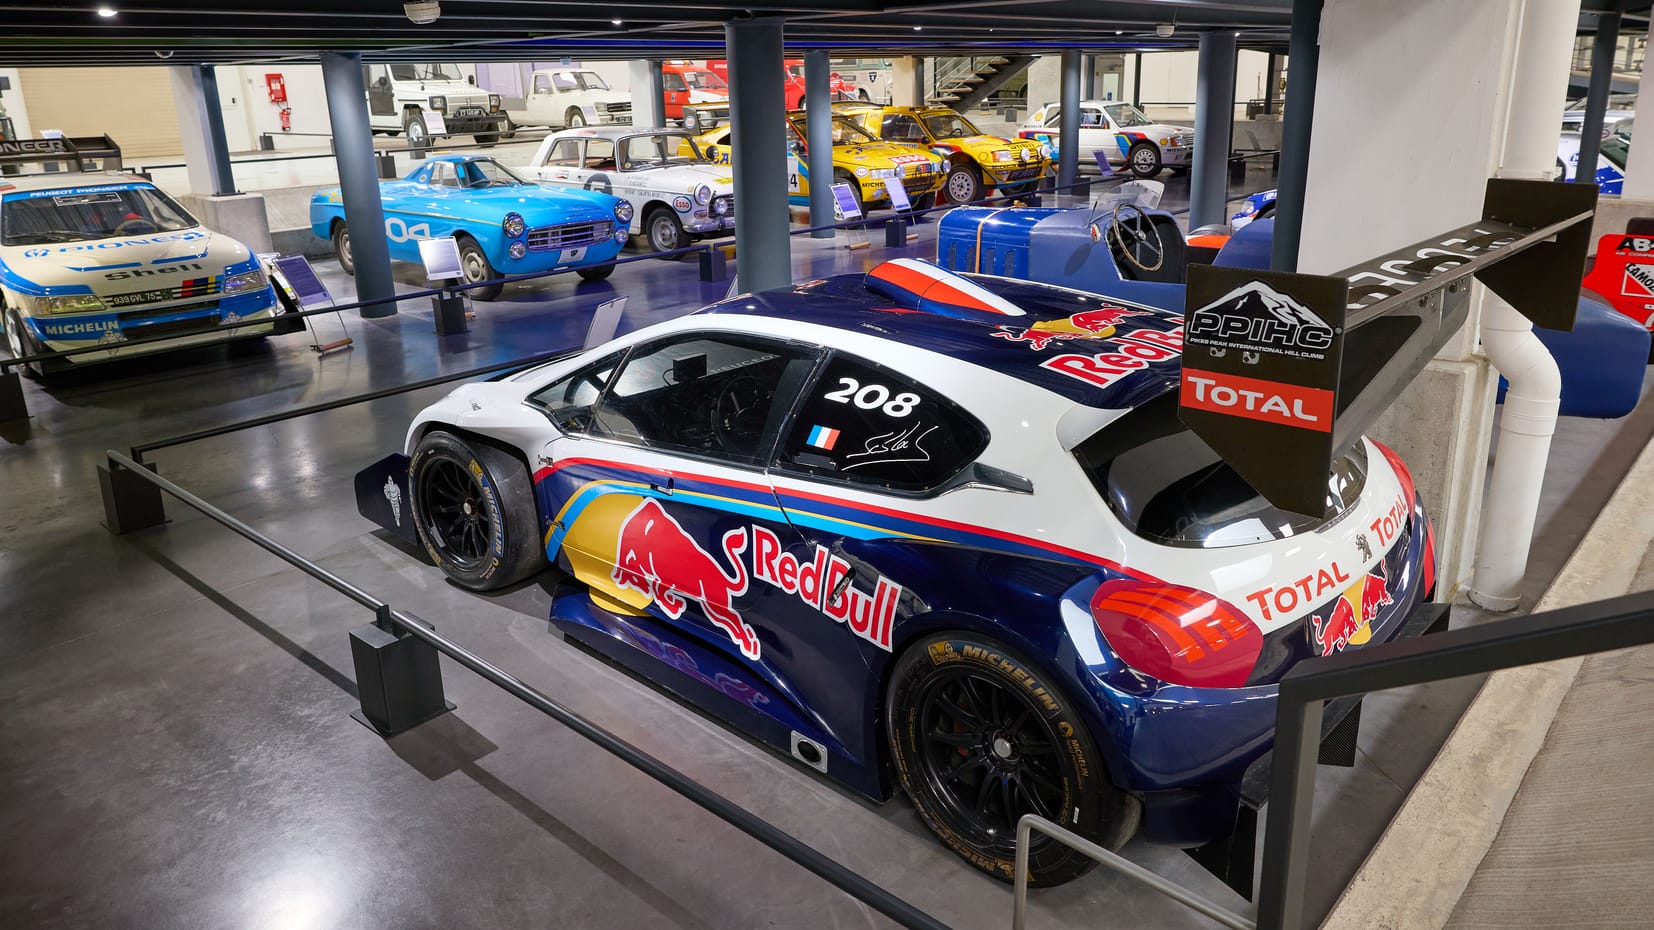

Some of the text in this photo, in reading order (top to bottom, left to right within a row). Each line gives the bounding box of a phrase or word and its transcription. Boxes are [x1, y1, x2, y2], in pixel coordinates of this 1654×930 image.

[0, 139, 67, 152] NEER
[30, 189, 73, 198] PEUGEOT
[75, 185, 128, 194] PIONEER
[1616, 237, 1654, 252] AB
[104, 264, 203, 281] Shell
[45, 320, 119, 335] MICHELIN
[1189, 311, 1334, 350] PPIHC
[1228, 342, 1284, 354] INTERNATIONAL
[824, 377, 921, 418] 208
[1187, 375, 1318, 422] TOTAL
[483, 486, 504, 557] MICHELIN
[1370, 494, 1408, 547] TOTAL
[1246, 561, 1350, 621] TOTAL
[962, 644, 1060, 711] MICHELIN
[1071, 738, 1089, 777] MICHELIN
